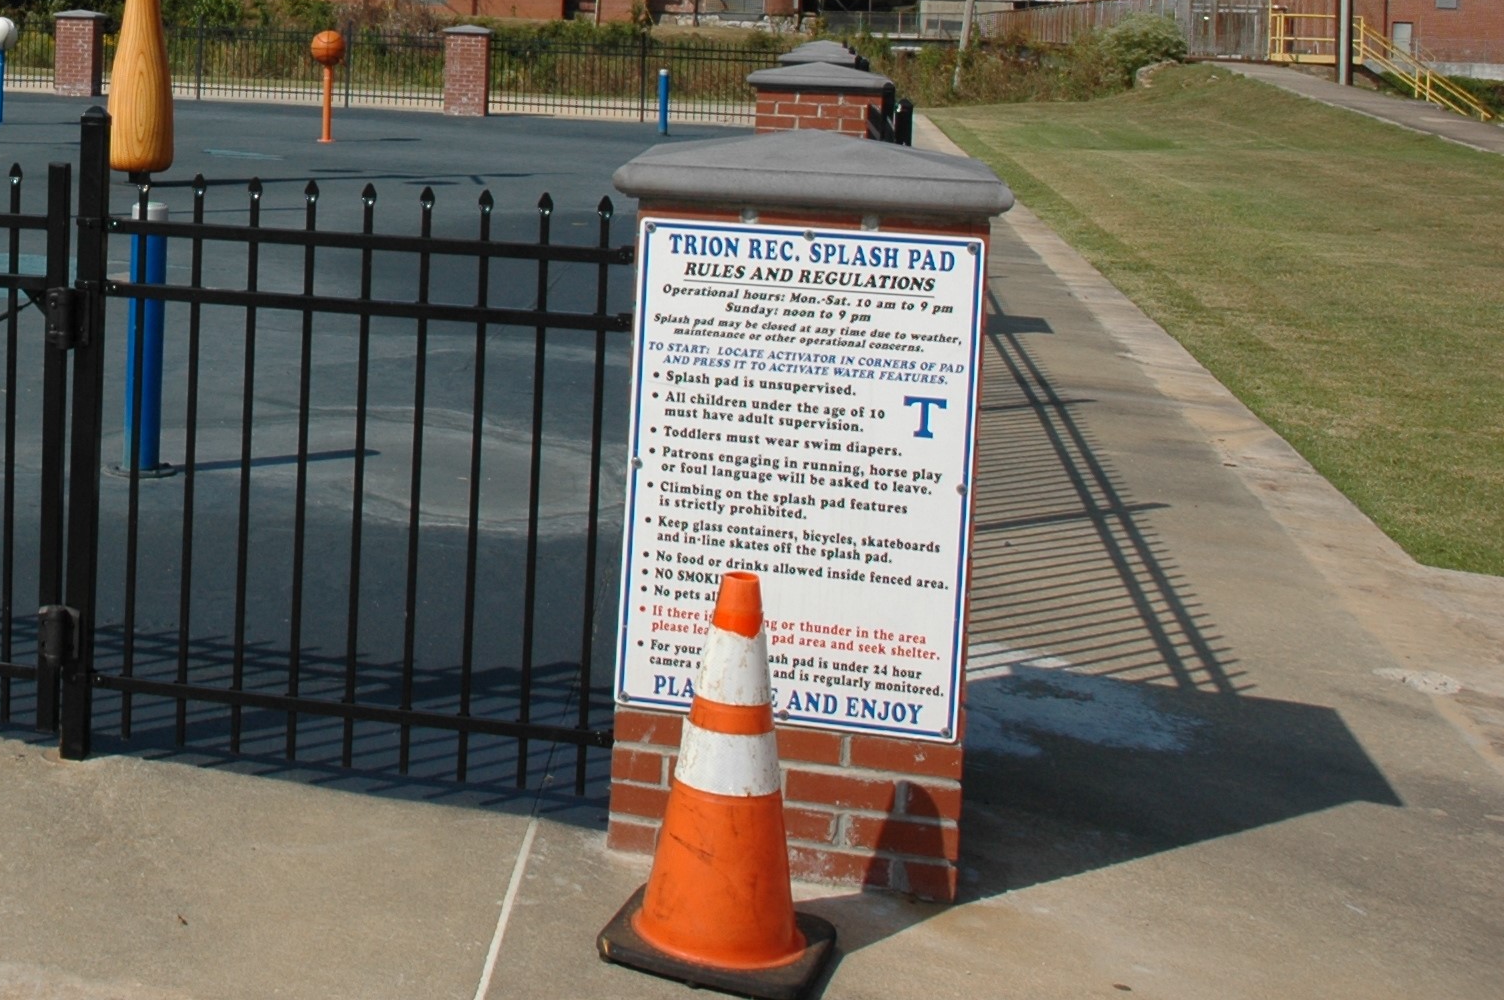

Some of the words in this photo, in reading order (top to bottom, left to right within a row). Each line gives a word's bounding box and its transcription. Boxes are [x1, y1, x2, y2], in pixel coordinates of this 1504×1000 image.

[668, 233, 740, 258] TRION
[747, 237, 800, 262] REC.
[808, 242, 900, 269] SPLASH
[907, 248, 956, 272] PAD
[683, 261, 746, 279] RULES
[748, 266, 794, 283] AND
[797, 268, 936, 292] REGULATIONS
[662, 283, 740, 299] Operational
[742, 289, 786, 302] hours:
[855, 298, 872, 308] 10
[875, 300, 896, 310] am
[900, 300, 915, 311] to
[920, 300, 929, 312] 9
[931, 304, 954, 315] pm
[724, 301, 779, 318] Sunday:
[782, 308, 815, 318] noon
[819, 309, 833, 319] to
[838, 309, 847, 320] 9
[849, 313, 871, 324] pm
[653, 312, 690, 324] Splash
[692, 317, 715, 327] pad
[717, 319, 742, 330] may
[744, 319, 758, 329] be
[761, 321, 797, 332] closed
[799, 324, 812, 333] at
[814, 326, 836, 337] any
[839, 326, 867, 337] time
[869, 328, 891, 339] due
[894, 331, 907, 340] to
[910, 333, 962, 346] weather,
[673, 325, 746, 340] maintenance
[748, 333, 762, 341] or
[764, 332, 796, 343] other
[799, 336, 867, 349] operational
[868, 341, 924, 353] concerns.
[648, 340, 664, 351] TO
[666, 342, 710, 354] START:
[717, 346, 764, 359] LOCATE
[766, 350, 836, 364] ACTIVATOR
[839, 355, 855, 365] IN
[857, 356, 917, 370] CORNERS
[919, 361, 937, 372] OF
[938, 362, 965, 374] PAD
[662, 354, 690, 365] AND
[692, 356, 731, 368] PRESS
[733, 359, 747, 369] IT
[750, 360, 766, 371] TO
[768, 362, 830, 376] ACTIVATE
[833, 366, 875, 379] WATER
[878, 370, 948, 385] FEATURES.
[665, 369, 710, 385] Splash
[714, 375, 739, 388] pad
[743, 375, 754, 388] is
[758, 380, 856, 396] unsupervised.
[664, 390, 686, 404] All
[689, 393, 747, 409] children
[751, 399, 792, 412] under
[796, 401, 819, 414] the
[822, 406, 846, 419] age
[850, 405, 865, 418] of
[869, 408, 886, 419] 10
[664, 407, 698, 419] must
[702, 408, 734, 422] have
[737, 412, 774, 425] adult
[778, 416, 864, 433] supervision.
[903, 395, 948, 440] T
[663, 424, 722, 441] Toddlers
[726, 433, 760, 445] must
[764, 436, 800, 448] wear
[803, 438, 842, 452] swim
[845, 441, 902, 457] diapers.
[660, 462, 676, 473] or
[680, 461, 707, 476] foul
[711, 464, 773, 483] language
[776, 471, 805, 484] will
[809, 473, 825, 486] be
[829, 476, 869, 490] asked
[873, 479, 888, 492] to
[892, 480, 932, 495] leave.
[661, 445, 714, 462] Patrons
[718, 453, 780, 470] engaging
[784, 456, 798, 469] in
[802, 460, 865, 478] running,
[868, 463, 908, 478] horse
[911, 468, 943, 484] play
[658, 494, 670, 507] is
[674, 497, 726, 514] strictly
[729, 503, 807, 520] prohibited.
[659, 480, 722, 500] Climbing
[725, 489, 742, 500] on
[746, 489, 769, 502] the
[772, 492, 816, 506] splash
[819, 497, 845, 510] pad
[849, 497, 908, 514] features
[656, 531, 680, 543] and
[683, 531, 726, 547] in-line
[729, 537, 769, 552] skates
[772, 541, 792, 554] off
[795, 543, 817, 556] the
[820, 547, 861, 561] splash
[864, 551, 892, 564] pad.
[657, 515, 689, 531] Keep
[692, 519, 723, 533] glass
[726, 524, 798, 543] containers,
[802, 529, 857, 549] bicycles,
[860, 535, 941, 553] skateboards
[654, 566, 674, 580] NO
[655, 549, 673, 562] No
[676, 551, 704, 566] food
[707, 557, 722, 568] or
[725, 557, 769, 572] drinks
[772, 562, 823, 578] allowed
[826, 567, 866, 582] inside
[869, 571, 912, 587] fenced
[915, 578, 949, 590] area.
[653, 584, 671, 597] No
[674, 589, 701, 601] pets
[651, 619, 689, 633] please
[771, 633, 794, 645] pad
[798, 637, 826, 648] area
[830, 640, 854, 651] and
[857, 642, 886, 655] seek
[890, 645, 940, 660] shelter.
[652, 604, 663, 616] If
[666, 607, 700, 620] there
[781, 621, 795, 631] or
[799, 621, 852, 637] thunder
[855, 626, 869, 639] in
[873, 628, 894, 641] the
[898, 633, 926, 645] area
[649, 655, 692, 669] camera
[772, 668, 795, 680] and
[799, 669, 809, 682] is
[812, 674, 871, 692] regularly
[874, 681, 944, 697] monitored.
[650, 638, 670, 652] For
[673, 644, 702, 655] your
[792, 656, 815, 668] pad
[817, 656, 828, 670] is
[832, 660, 869, 674] under
[872, 664, 888, 676] 24
[891, 665, 922, 680] hour
[653, 673, 695, 699] PLA
[785, 689, 838, 715] AND
[844, 696, 923, 725] ENJOY
